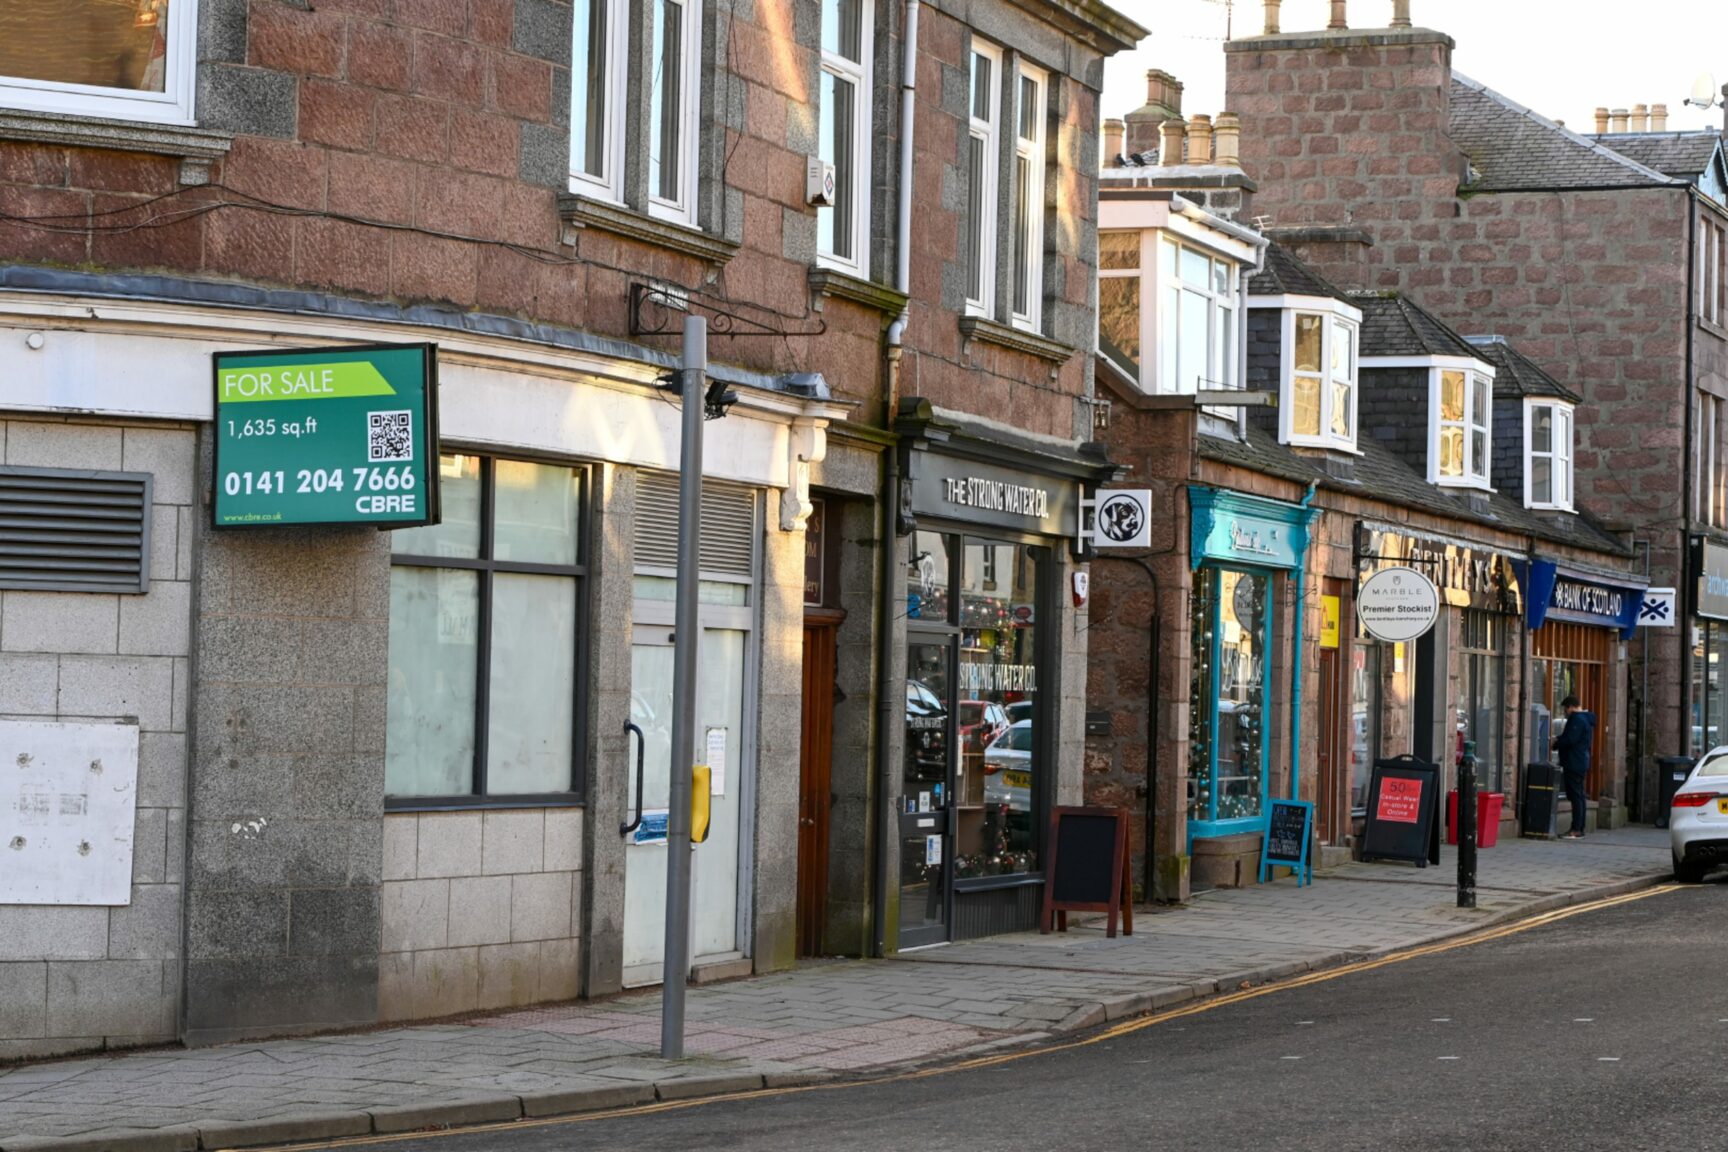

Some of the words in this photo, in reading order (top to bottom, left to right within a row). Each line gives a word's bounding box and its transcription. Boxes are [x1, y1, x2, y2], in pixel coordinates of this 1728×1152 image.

[224, 373, 273, 397] FOR
[281, 369, 334, 395] SALE
[228, 418, 276, 439] 1,635
[281, 416, 318, 438] sq.ft
[224, 470, 284, 495] 0141
[296, 468, 344, 494] 204
[353, 466, 415, 491] 7666
[355, 494, 416, 513] CBRE
[946, 477, 967, 504] THE
[967, 476, 1003, 510] STRONG
[1004, 482, 1035, 515] WATER
[1035, 488, 1049, 519] CO.
[223, 511, 282, 521] www.cbre.co.uk
[1372, 587, 1423, 596] MARBLE
[1564, 583, 1582, 610] BANK
[1582, 586, 1592, 612] OF
[1592, 587, 1622, 617] SCOTLAND
[1362, 604, 1395, 613] Premier
[1397, 604, 1432, 613] Stockist
[959, 662, 994, 691] STRONG
[994, 664, 1024, 692] WATER
[1024, 665, 1038, 692] CO.
